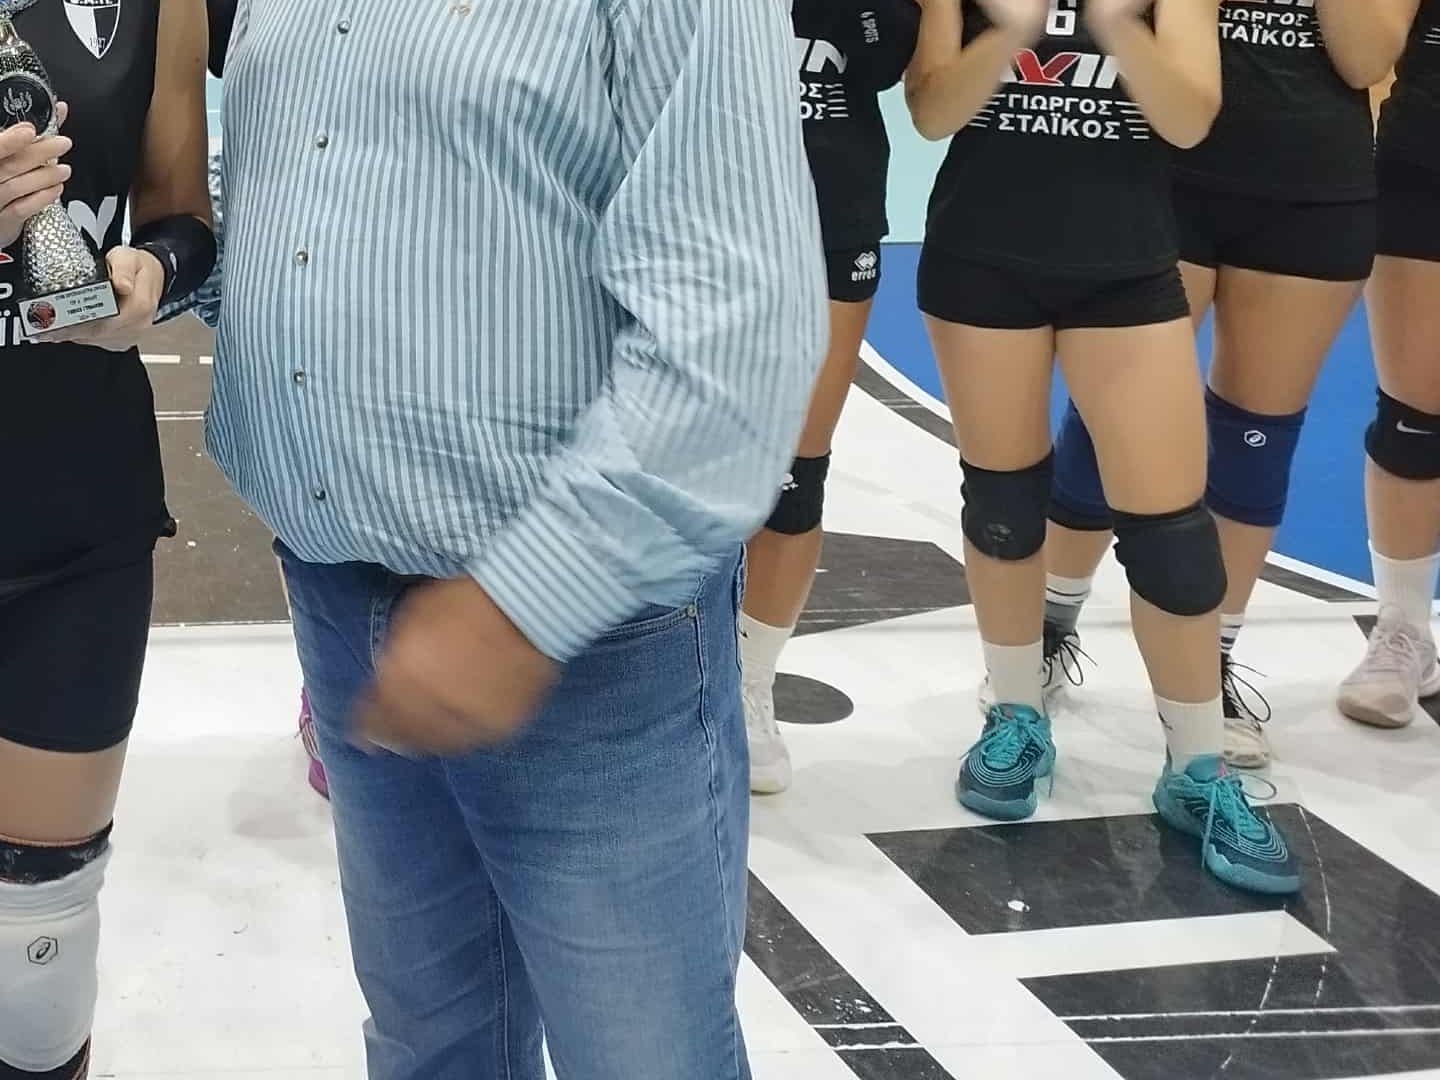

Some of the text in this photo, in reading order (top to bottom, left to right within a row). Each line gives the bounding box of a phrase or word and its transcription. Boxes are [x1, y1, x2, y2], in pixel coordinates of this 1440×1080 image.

[1222, 7, 1310, 27] ΙΩΡΓΟΣ
[1217, 21, 1316, 48] ΤΑΪΚΟΣ
[1008, 93, 1113, 115] ΓΙΩΡΓΟΣ
[998, 112, 1121, 140] ΣΤΑΪΚΟΣ
